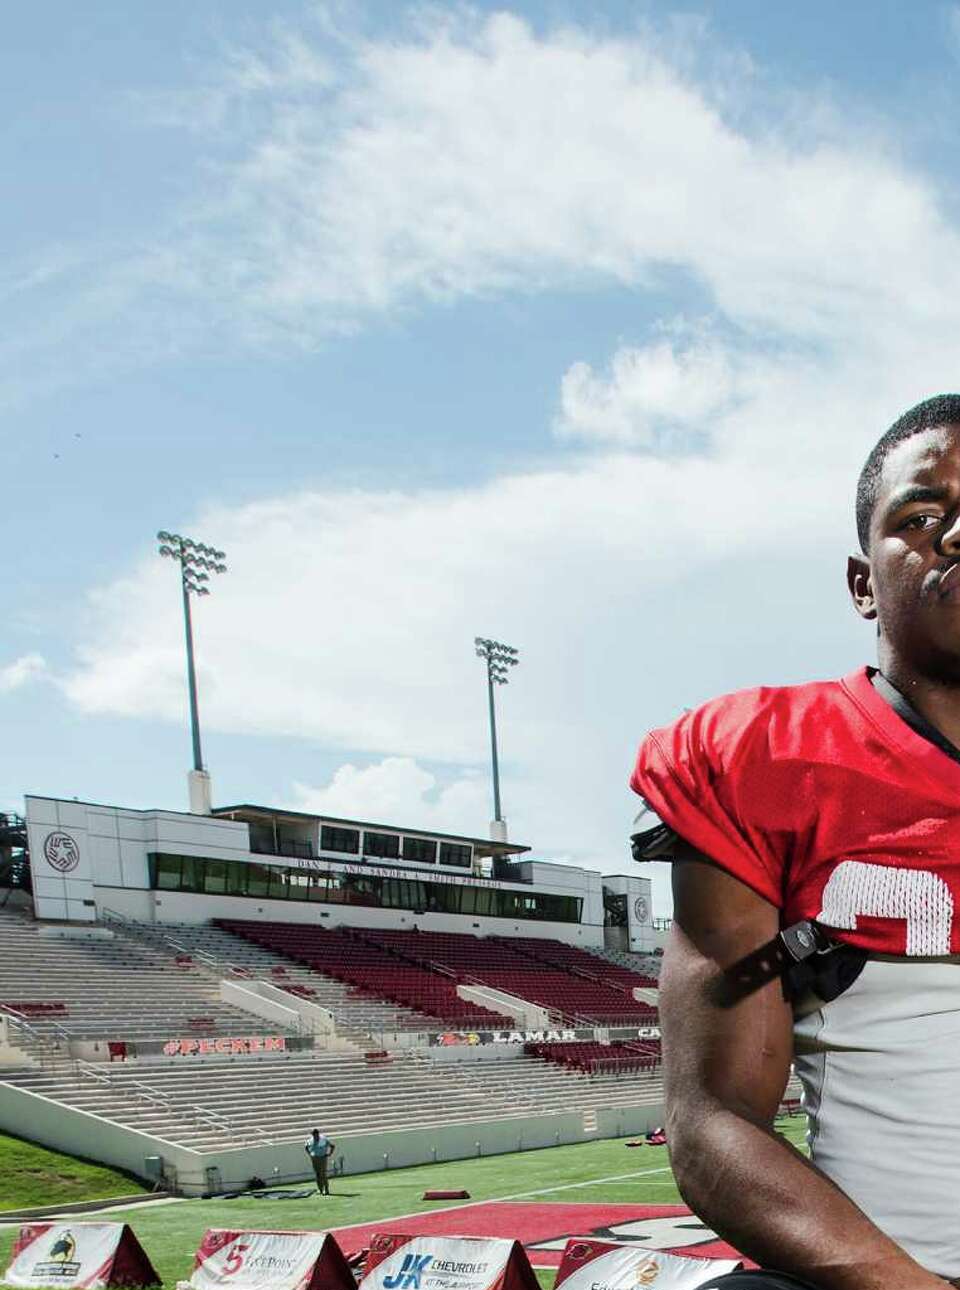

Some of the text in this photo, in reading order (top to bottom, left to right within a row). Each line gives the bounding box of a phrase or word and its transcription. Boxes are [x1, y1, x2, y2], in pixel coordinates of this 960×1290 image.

[493, 1030, 577, 1043] LAMAR
[223, 1244, 250, 1275] 5
[383, 1254, 489, 1289] JK CHEVROLET
